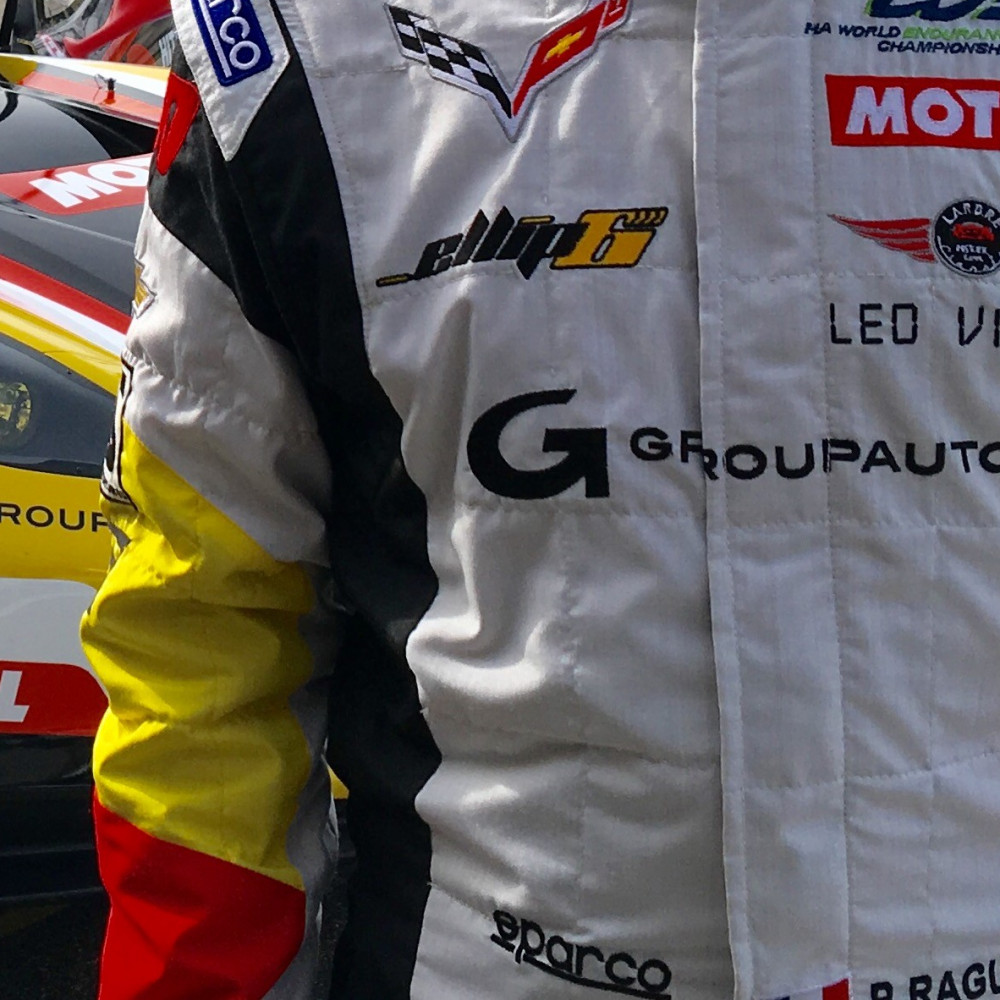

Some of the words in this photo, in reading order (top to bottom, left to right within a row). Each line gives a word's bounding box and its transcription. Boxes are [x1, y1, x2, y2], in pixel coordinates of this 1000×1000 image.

[839, 23, 901, 38] WORLD
[845, 85, 1000, 139] MOT
[829, 303, 919, 345] LEO
[491, 909, 672, 994] sparco
